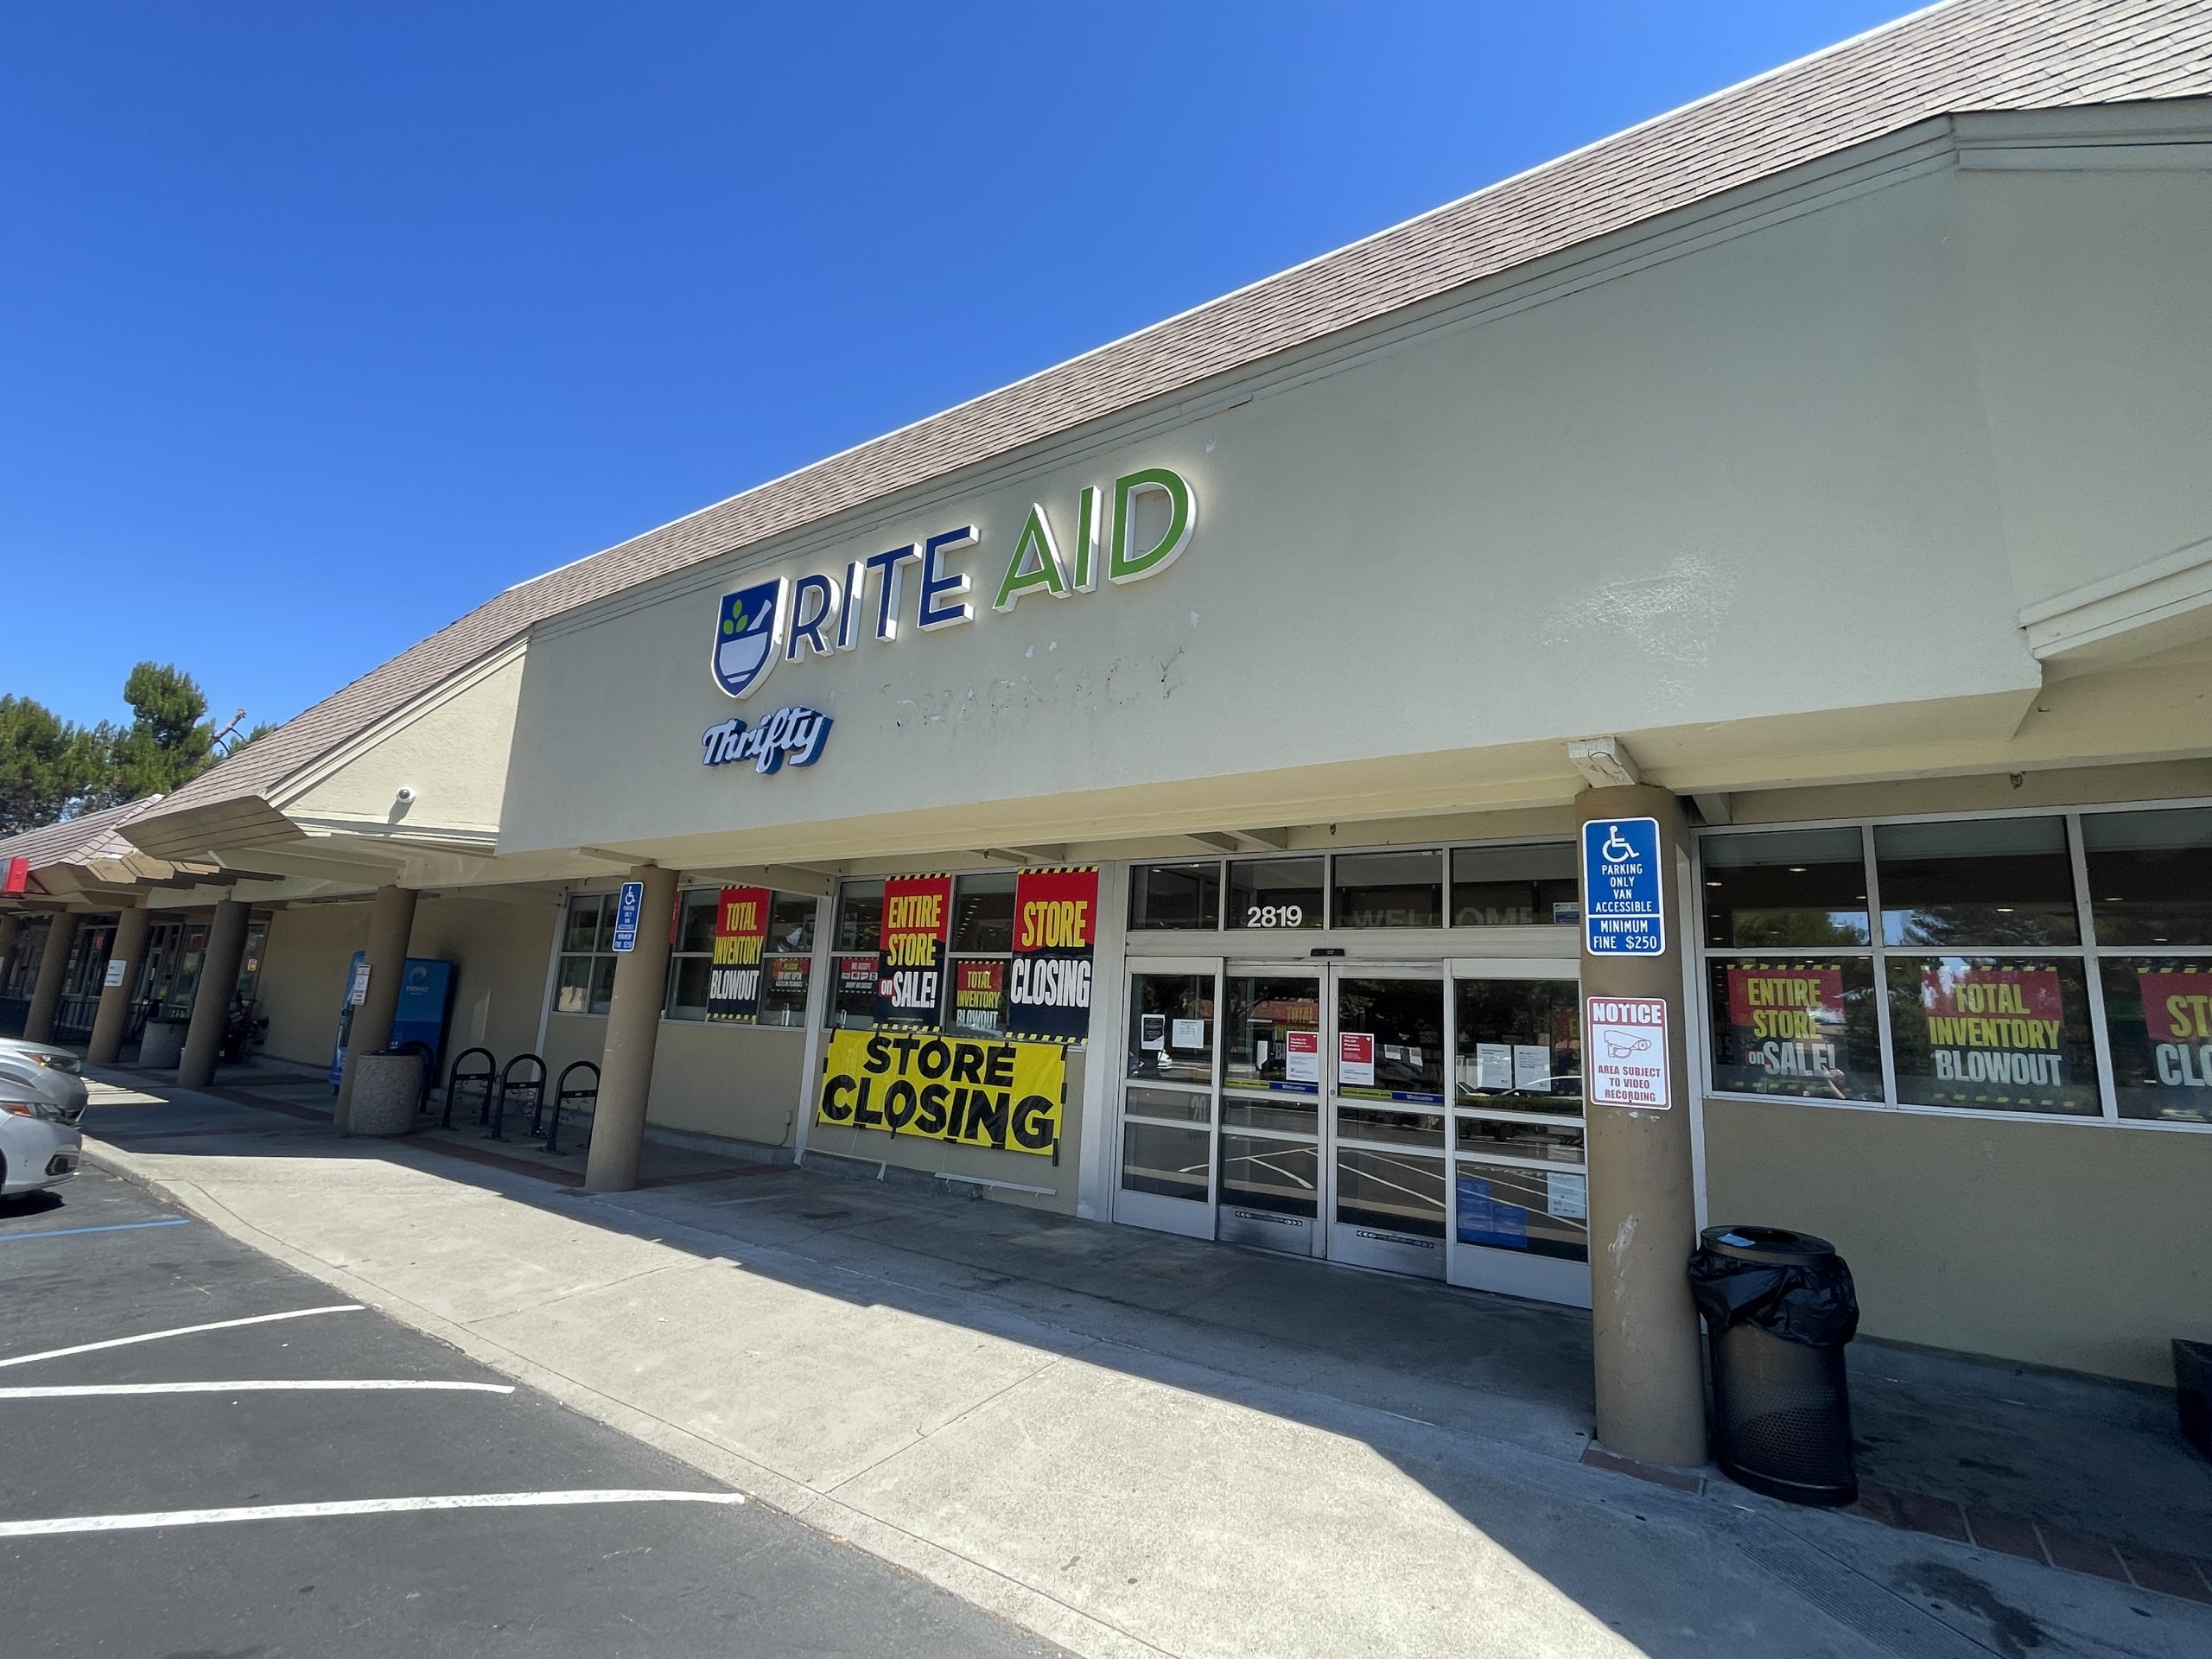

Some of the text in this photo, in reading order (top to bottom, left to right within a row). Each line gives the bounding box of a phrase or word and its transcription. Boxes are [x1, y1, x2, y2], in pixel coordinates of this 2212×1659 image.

[785, 468, 1197, 663] RITE AID
[702, 705, 833, 776] Thrifty
[1602, 864, 1643, 874] PARKING
[1610, 877, 1635, 887] ONLY
[1595, 901, 1652, 912] ACCESSIBLE
[1613, 889, 1631, 899] VAN
[726, 902, 757, 931] TOTAL
[888, 895, 942, 928] ENTIRE
[1022, 901, 1087, 947] STORE
[1247, 906, 1302, 928] 2819
[1352, 907, 1534, 926] WELOME
[1600, 920, 1648, 932] MINIMUM
[713, 936, 764, 965] INVENTORY
[887, 933, 938, 966] STORE
[1593, 935, 1657, 950] FINE $250
[709, 969, 760, 1001] BLOWOUT
[881, 971, 938, 1008] on SALE!
[968, 971, 991, 988] TOTAL
[1011, 958, 1090, 1007] CLOSING
[1747, 978, 1822, 1007] ENTIRE
[957, 991, 1001, 1008] INVENTORY
[1954, 982, 2031, 1014] TOTAL
[957, 1009, 999, 1029] BLOWOUT
[1592, 1002, 1662, 1024] NOTICE
[1752, 1009, 1823, 1039] STORE
[2166, 995, 2212, 1037] ST
[1929, 1016, 2060, 1050] INVENTORY
[863, 1037, 1016, 1087] STORE
[1598, 1065, 1661, 1077] AREA SUBJECT
[1748, 1041, 1835, 1077] on SALE!
[1936, 1050, 2063, 1086] BLOWOUT
[1605, 1090, 1656, 1102] RECORDING
[1609, 1077, 1650, 1090] TO VIDEO
[822, 1074, 1054, 1148] CLOSING
